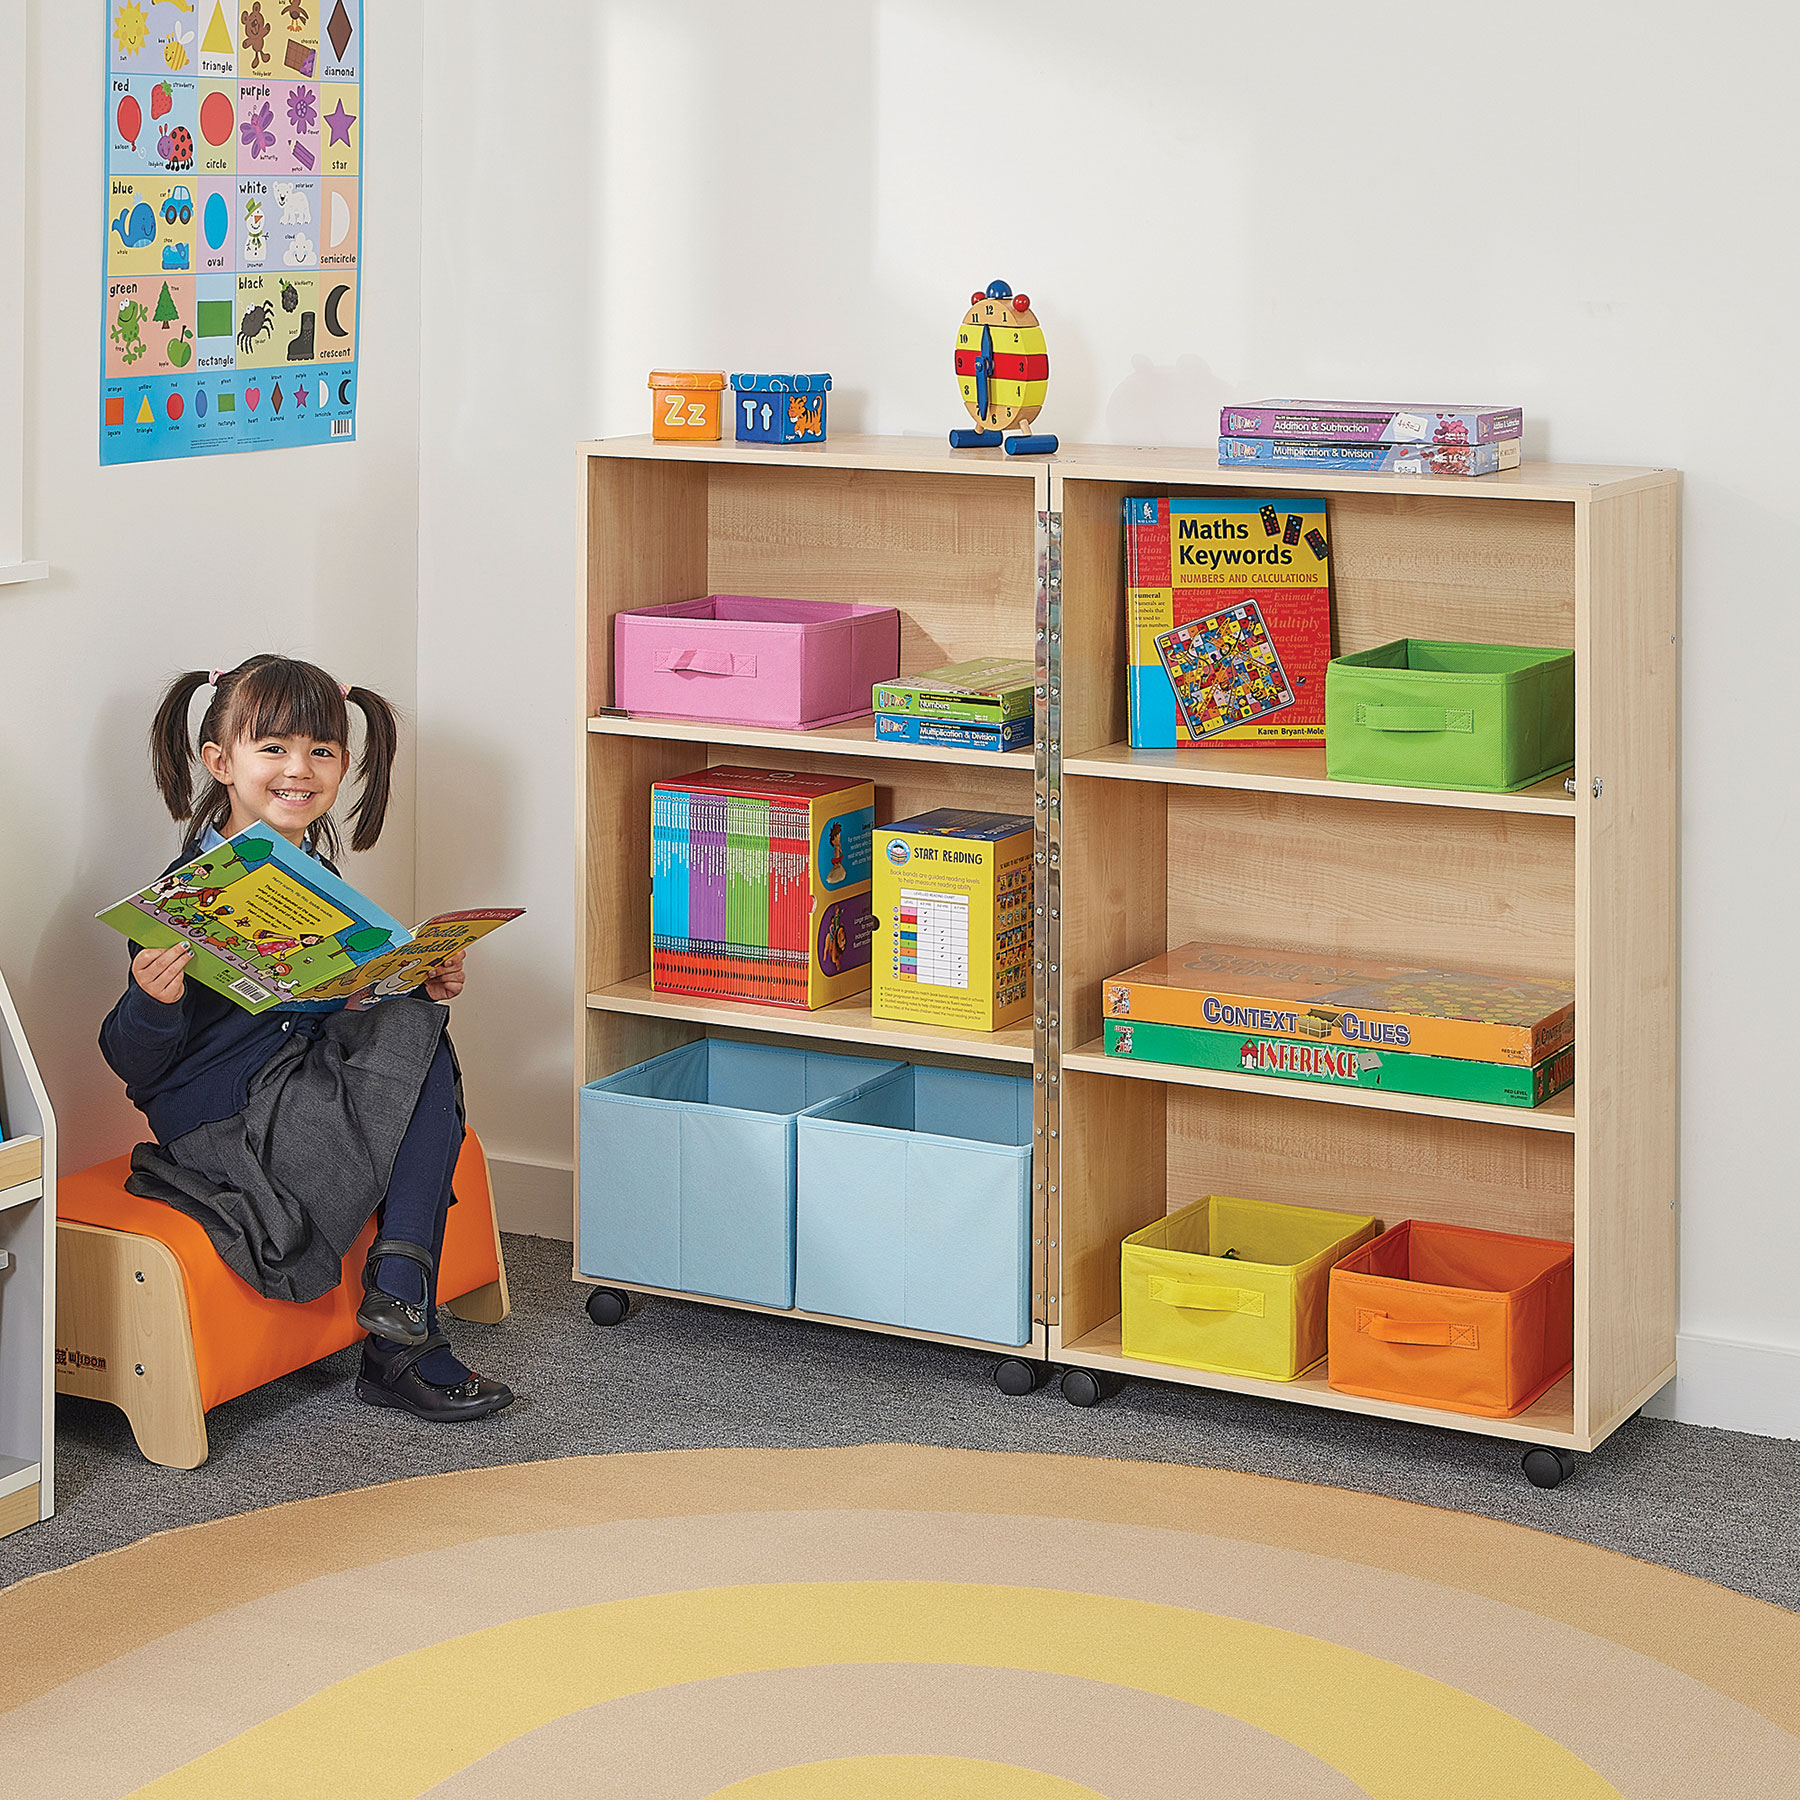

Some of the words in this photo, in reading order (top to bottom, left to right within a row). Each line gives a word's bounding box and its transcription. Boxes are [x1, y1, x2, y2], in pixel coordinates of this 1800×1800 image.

[202, 60, 233, 74] triangle
[324, 66, 355, 77] diamond
[112, 78, 130, 92] red
[240, 84, 271, 100] purple
[206, 158, 227, 169] circle
[332, 160, 348, 170] star
[112, 181, 134, 194] blue
[239, 181, 268, 194] white
[207, 257, 224, 267] oval
[320, 254, 356, 264] semicircle
[238, 276, 264, 289] black
[110, 282, 138, 298] green
[986, 305, 994, 316] 12
[972, 313, 979, 323] 11
[1002, 312, 1008, 322] 1
[960, 334, 968, 344] 10
[1014, 332, 1019, 343] 2
[320, 347, 351, 358] crescent
[198, 354, 234, 368] rectangle
[957, 357, 963, 368] 9
[1019, 362, 1025, 373] 3
[138, 384, 152, 392] yellow
[964, 385, 970, 396] 8
[1015, 386, 1021, 398] 4
[664, 394, 706, 426] Zz
[742, 400, 773, 431] Tt
[1006, 407, 1012, 418] 5
[992, 414, 997, 425] 6
[1274, 421, 1309, 431] Addition
[1311, 422, 1319, 431] &
[1320, 422, 1369, 433] Subtraction
[1273, 446, 1330, 458] Multiplication
[1332, 448, 1339, 457] &
[1341, 448, 1374, 459] Division
[1178, 518, 1249, 540] Maths
[1179, 544, 1293, 570] Keywords
[1180, 573, 1226, 584] NUMBERS
[1228, 573, 1248, 584] AND
[1251, 573, 1319, 584] CALCULATIONS
[1274, 592, 1316, 601] Estimate
[1267, 616, 1320, 632] Multiply
[920, 700, 950, 710] Numbers
[920, 727, 963, 738] Multiplication
[972, 732, 997, 742] Division
[1281, 728, 1324, 736] Bryant-Mole
[914, 847, 939, 861] START
[942, 850, 983, 865] READING
[393, 938, 460, 956] Waddle
[1202, 996, 1298, 1034] CONTEXT
[1340, 1012, 1411, 1046] CLUES
[1258, 1039, 1359, 1081] INFERENCE
